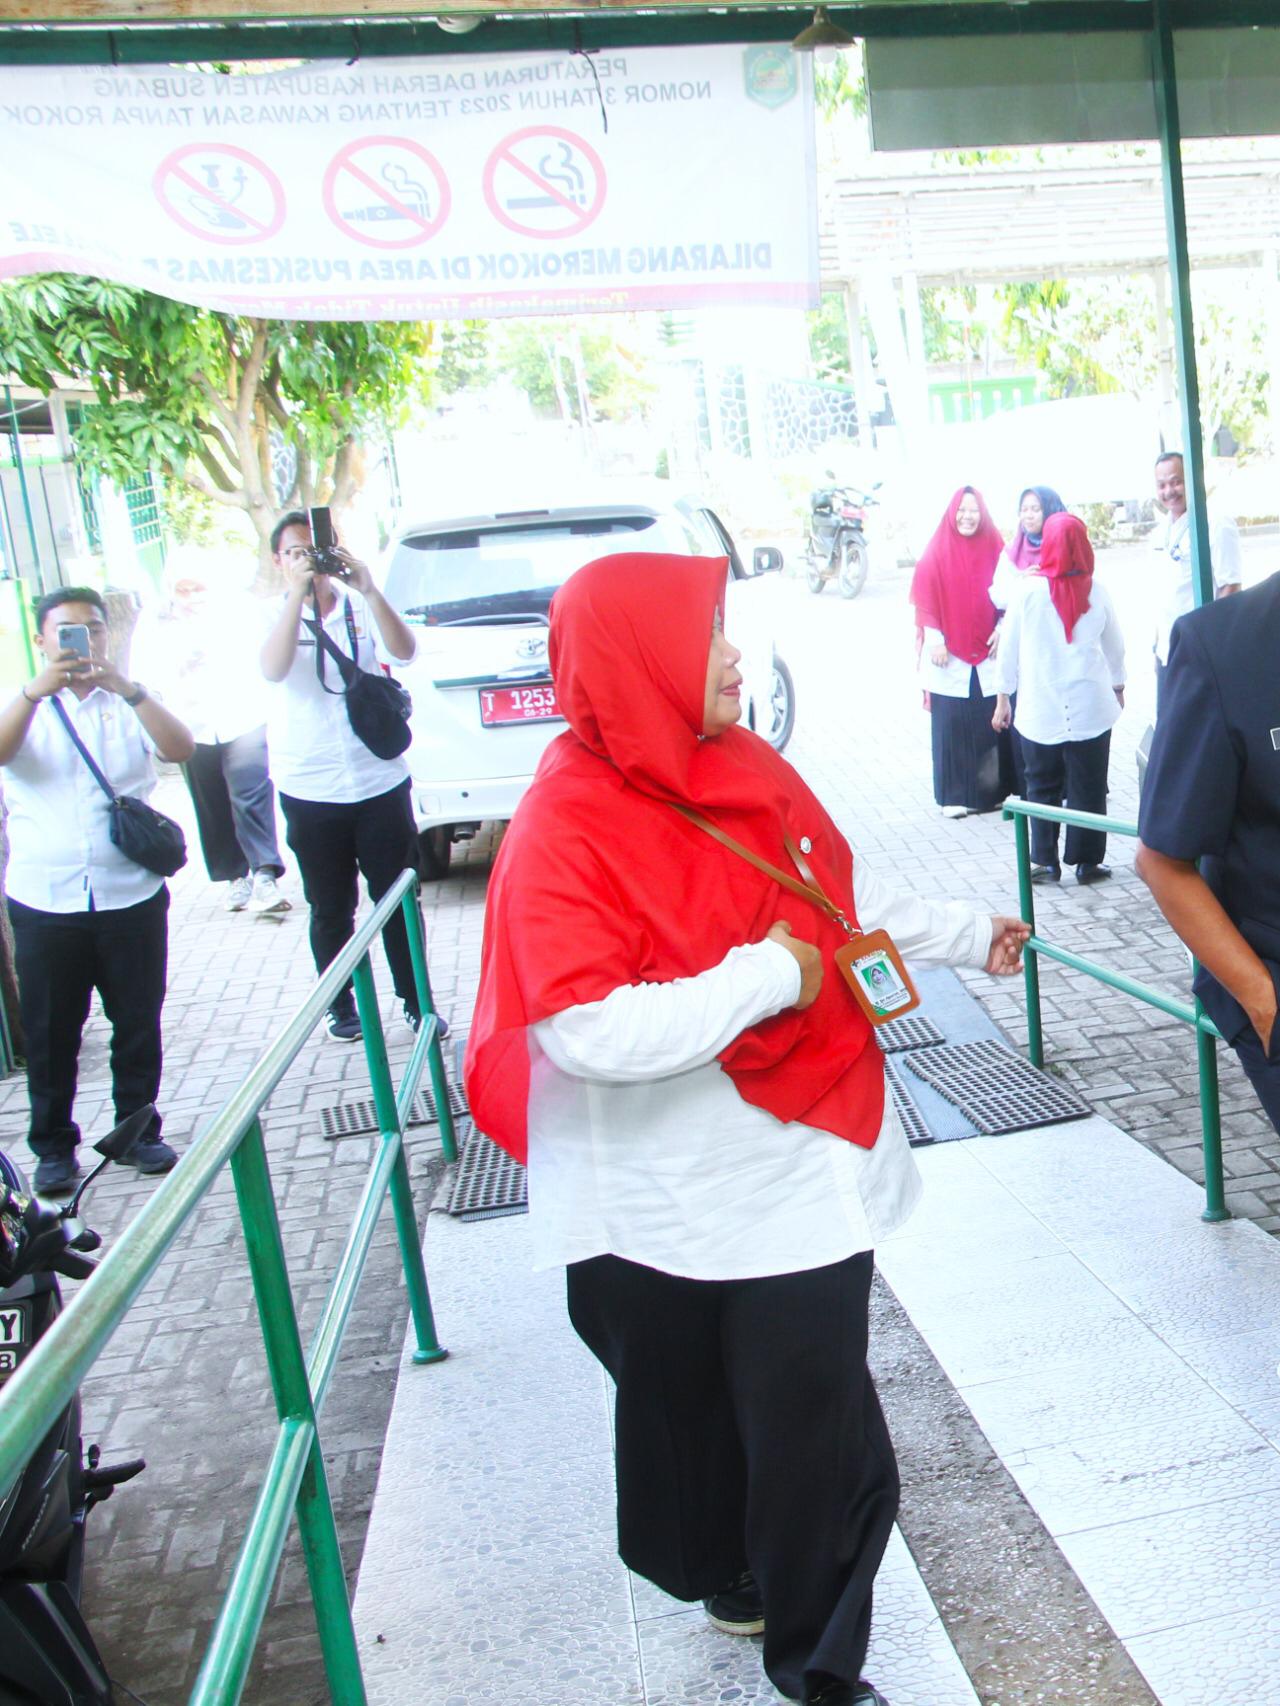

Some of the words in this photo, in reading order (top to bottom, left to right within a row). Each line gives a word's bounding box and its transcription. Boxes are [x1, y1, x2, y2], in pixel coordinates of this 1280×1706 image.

[481, 692, 495, 713] T
[511, 687, 556, 711] 1253
[0, 1312, 18, 1341] Y
